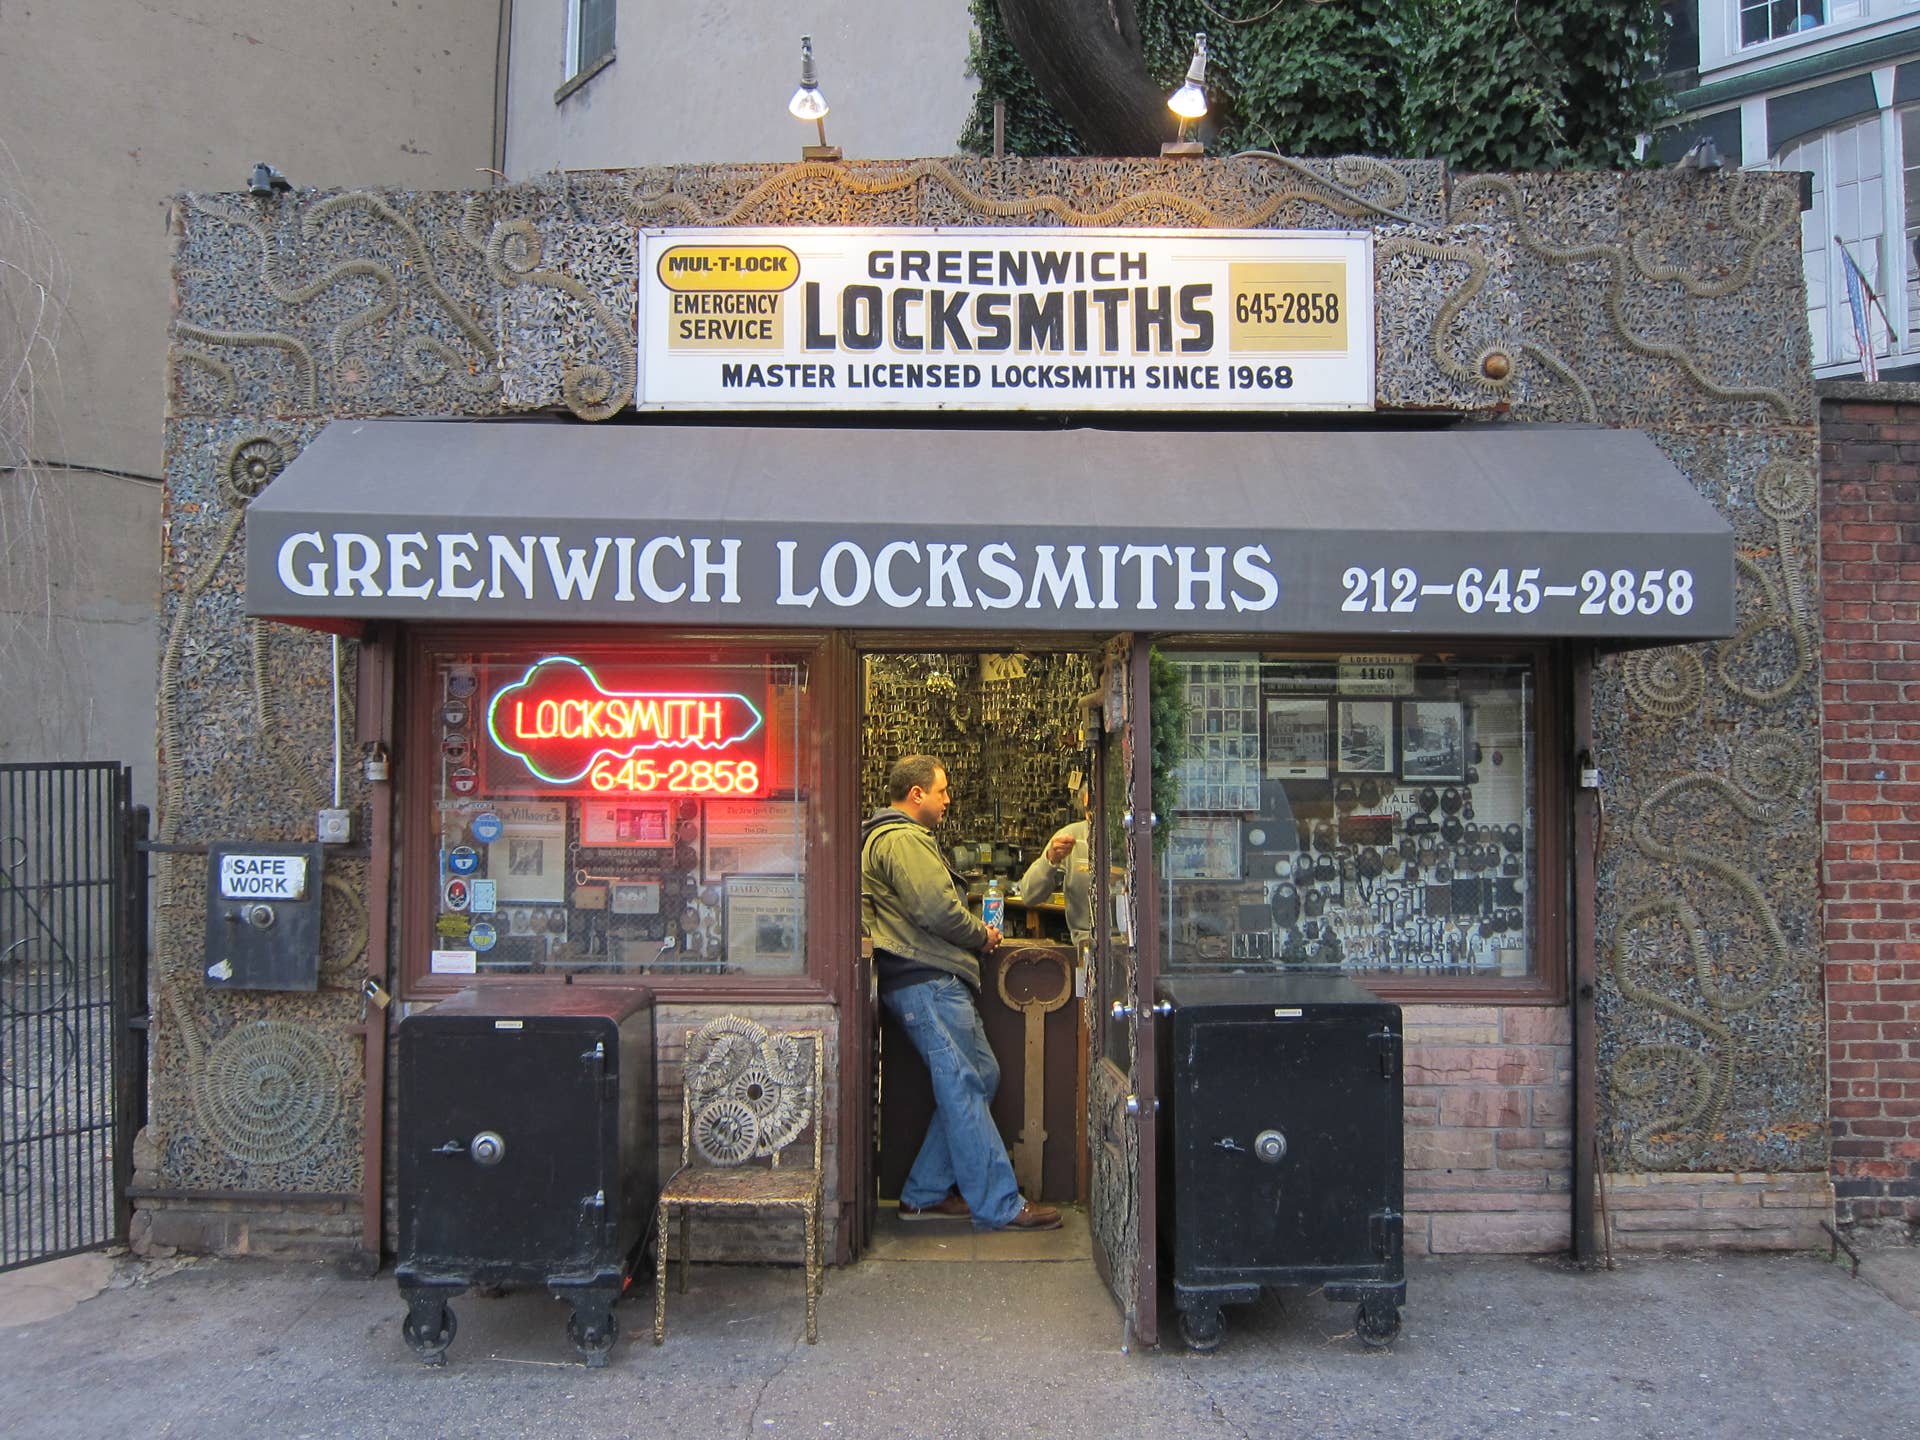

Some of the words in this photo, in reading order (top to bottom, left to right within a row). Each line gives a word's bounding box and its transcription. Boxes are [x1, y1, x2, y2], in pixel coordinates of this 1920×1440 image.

[668, 256, 787, 272] MUL-T-LOCK
[868, 250, 1147, 285] GREENWICH
[674, 294, 778, 314] EMERGENCY
[1236, 292, 1339, 324] 645-2858
[805, 282, 1214, 351] LOCKSMITHS
[679, 319, 772, 340] SERVICE
[722, 364, 836, 388] MASTER
[848, 364, 981, 388] LICENSED
[991, 365, 1135, 389] LOCKSMITH
[1146, 366, 1219, 389] SINCE
[1229, 365, 1293, 389] 1968
[278, 531, 742, 604] GREENWICH
[776, 537, 1279, 613] LOCKSMITHS
[1341, 567, 1694, 616] 212-645-2858
[1360, 668, 1395, 680] 4160
[514, 700, 723, 740] LOCKSMITH
[590, 759, 760, 794] 645-2858
[1383, 794, 1417, 804] YALE
[233, 859, 286, 875] SAFE
[229, 877, 289, 894] WORK
